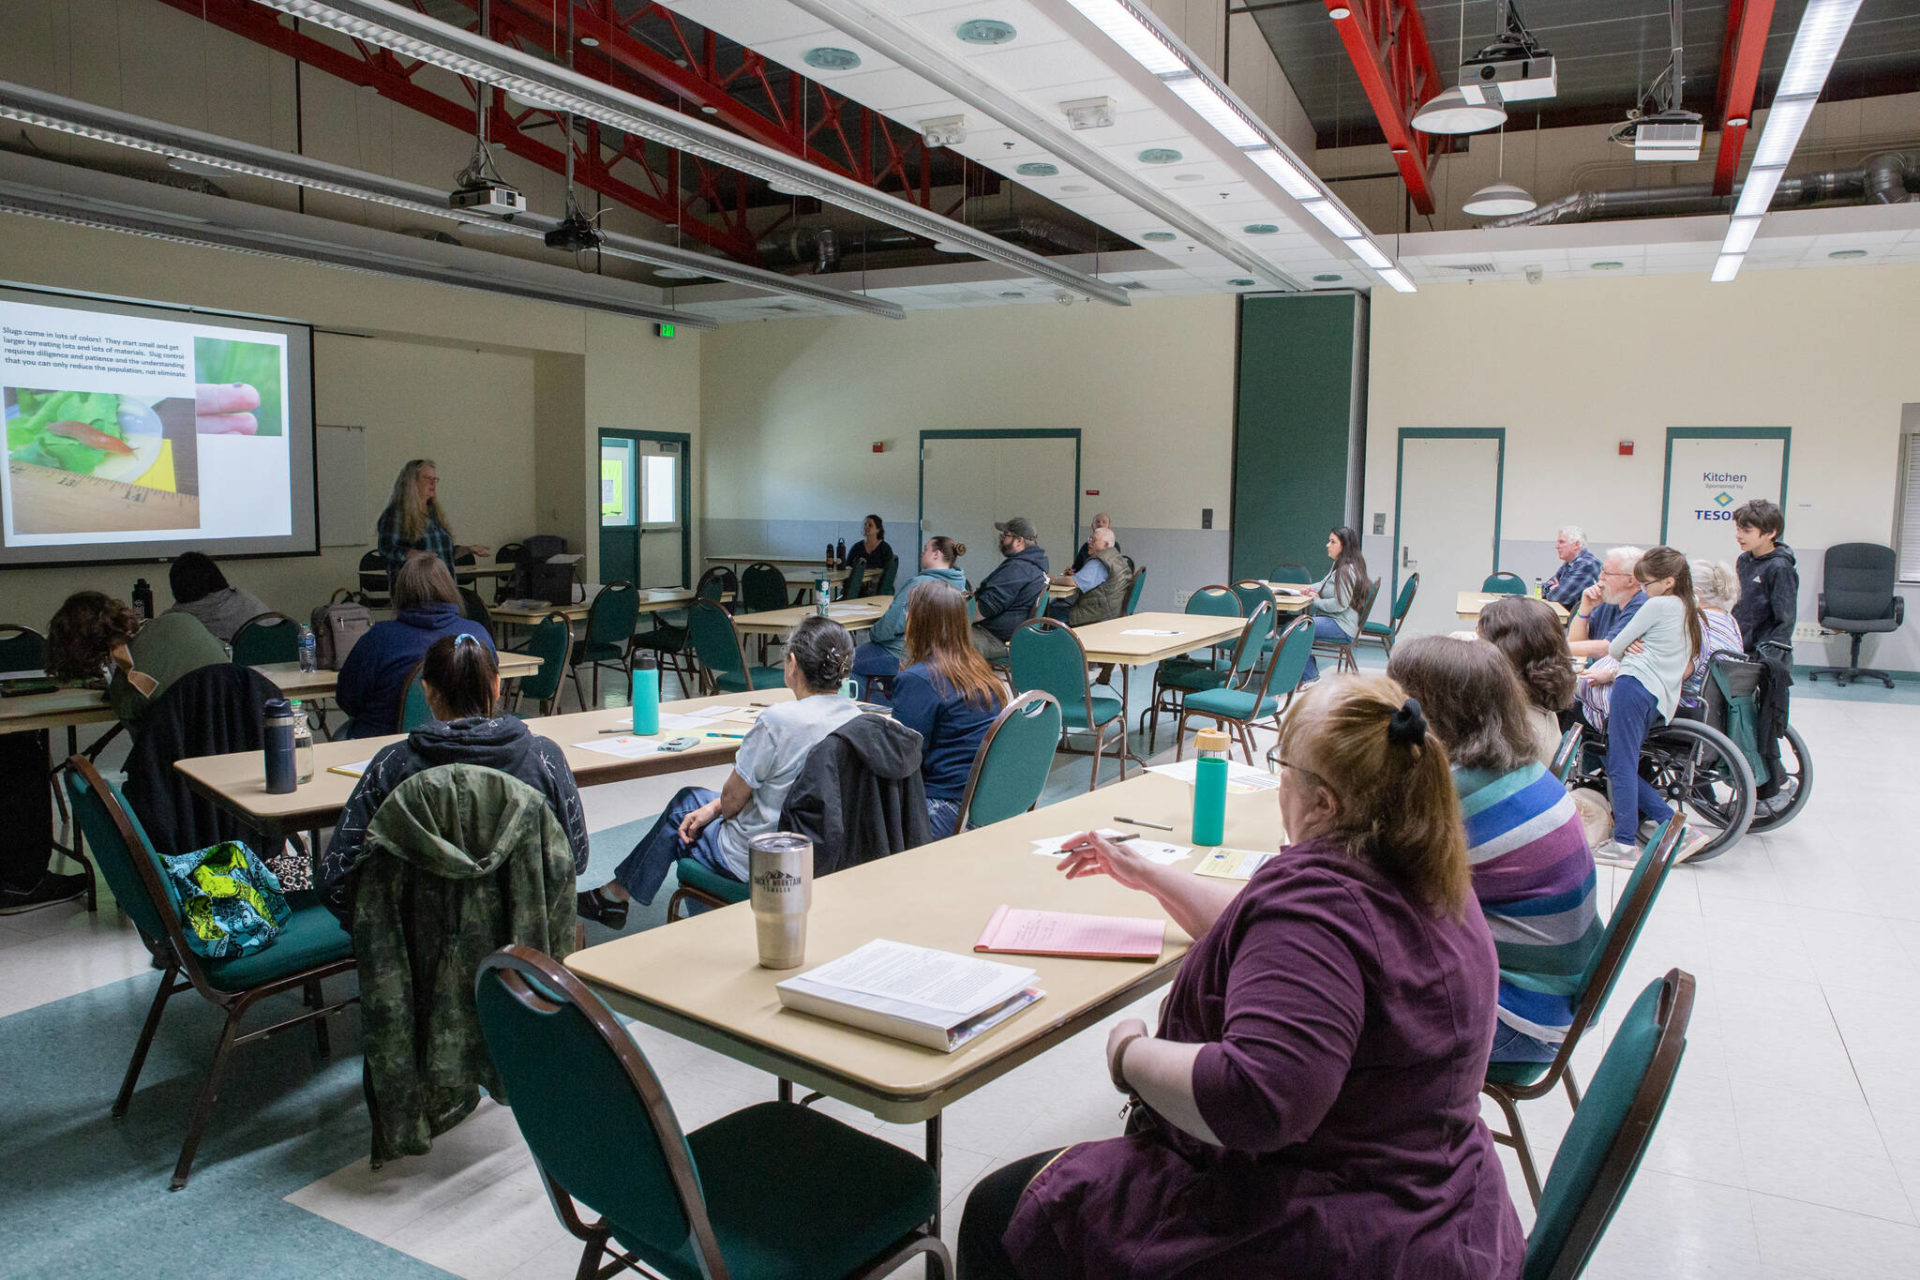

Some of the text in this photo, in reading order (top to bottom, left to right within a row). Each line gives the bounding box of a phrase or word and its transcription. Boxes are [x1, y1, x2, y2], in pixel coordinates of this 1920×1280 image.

[2, 327, 22, 336] Slugs
[55, 332, 68, 340] lots
[78, 335, 102, 343] colors!
[105, 337, 121, 346] They
[3, 337, 25, 345] larger
[27, 339, 37, 347] by
[38, 341, 61, 349] eating
[114, 348, 146, 356] materials.
[149, 351, 162, 359] Slug
[4, 347, 35, 356] requires
[36, 349, 68, 358] diligence
[85, 355, 114, 363] patience
[141, 359, 185, 369] understanding
[4, 357, 21, 365] that
[22, 359, 36, 367] you
[52, 361, 68, 369] only
[107, 366, 144, 374] population,
[58, 476, 76, 487] 13
[1703, 472, 1747, 482] Kitchen
[123, 490, 141, 502] 14
[772, 877, 802, 886] MOUNTAIN
